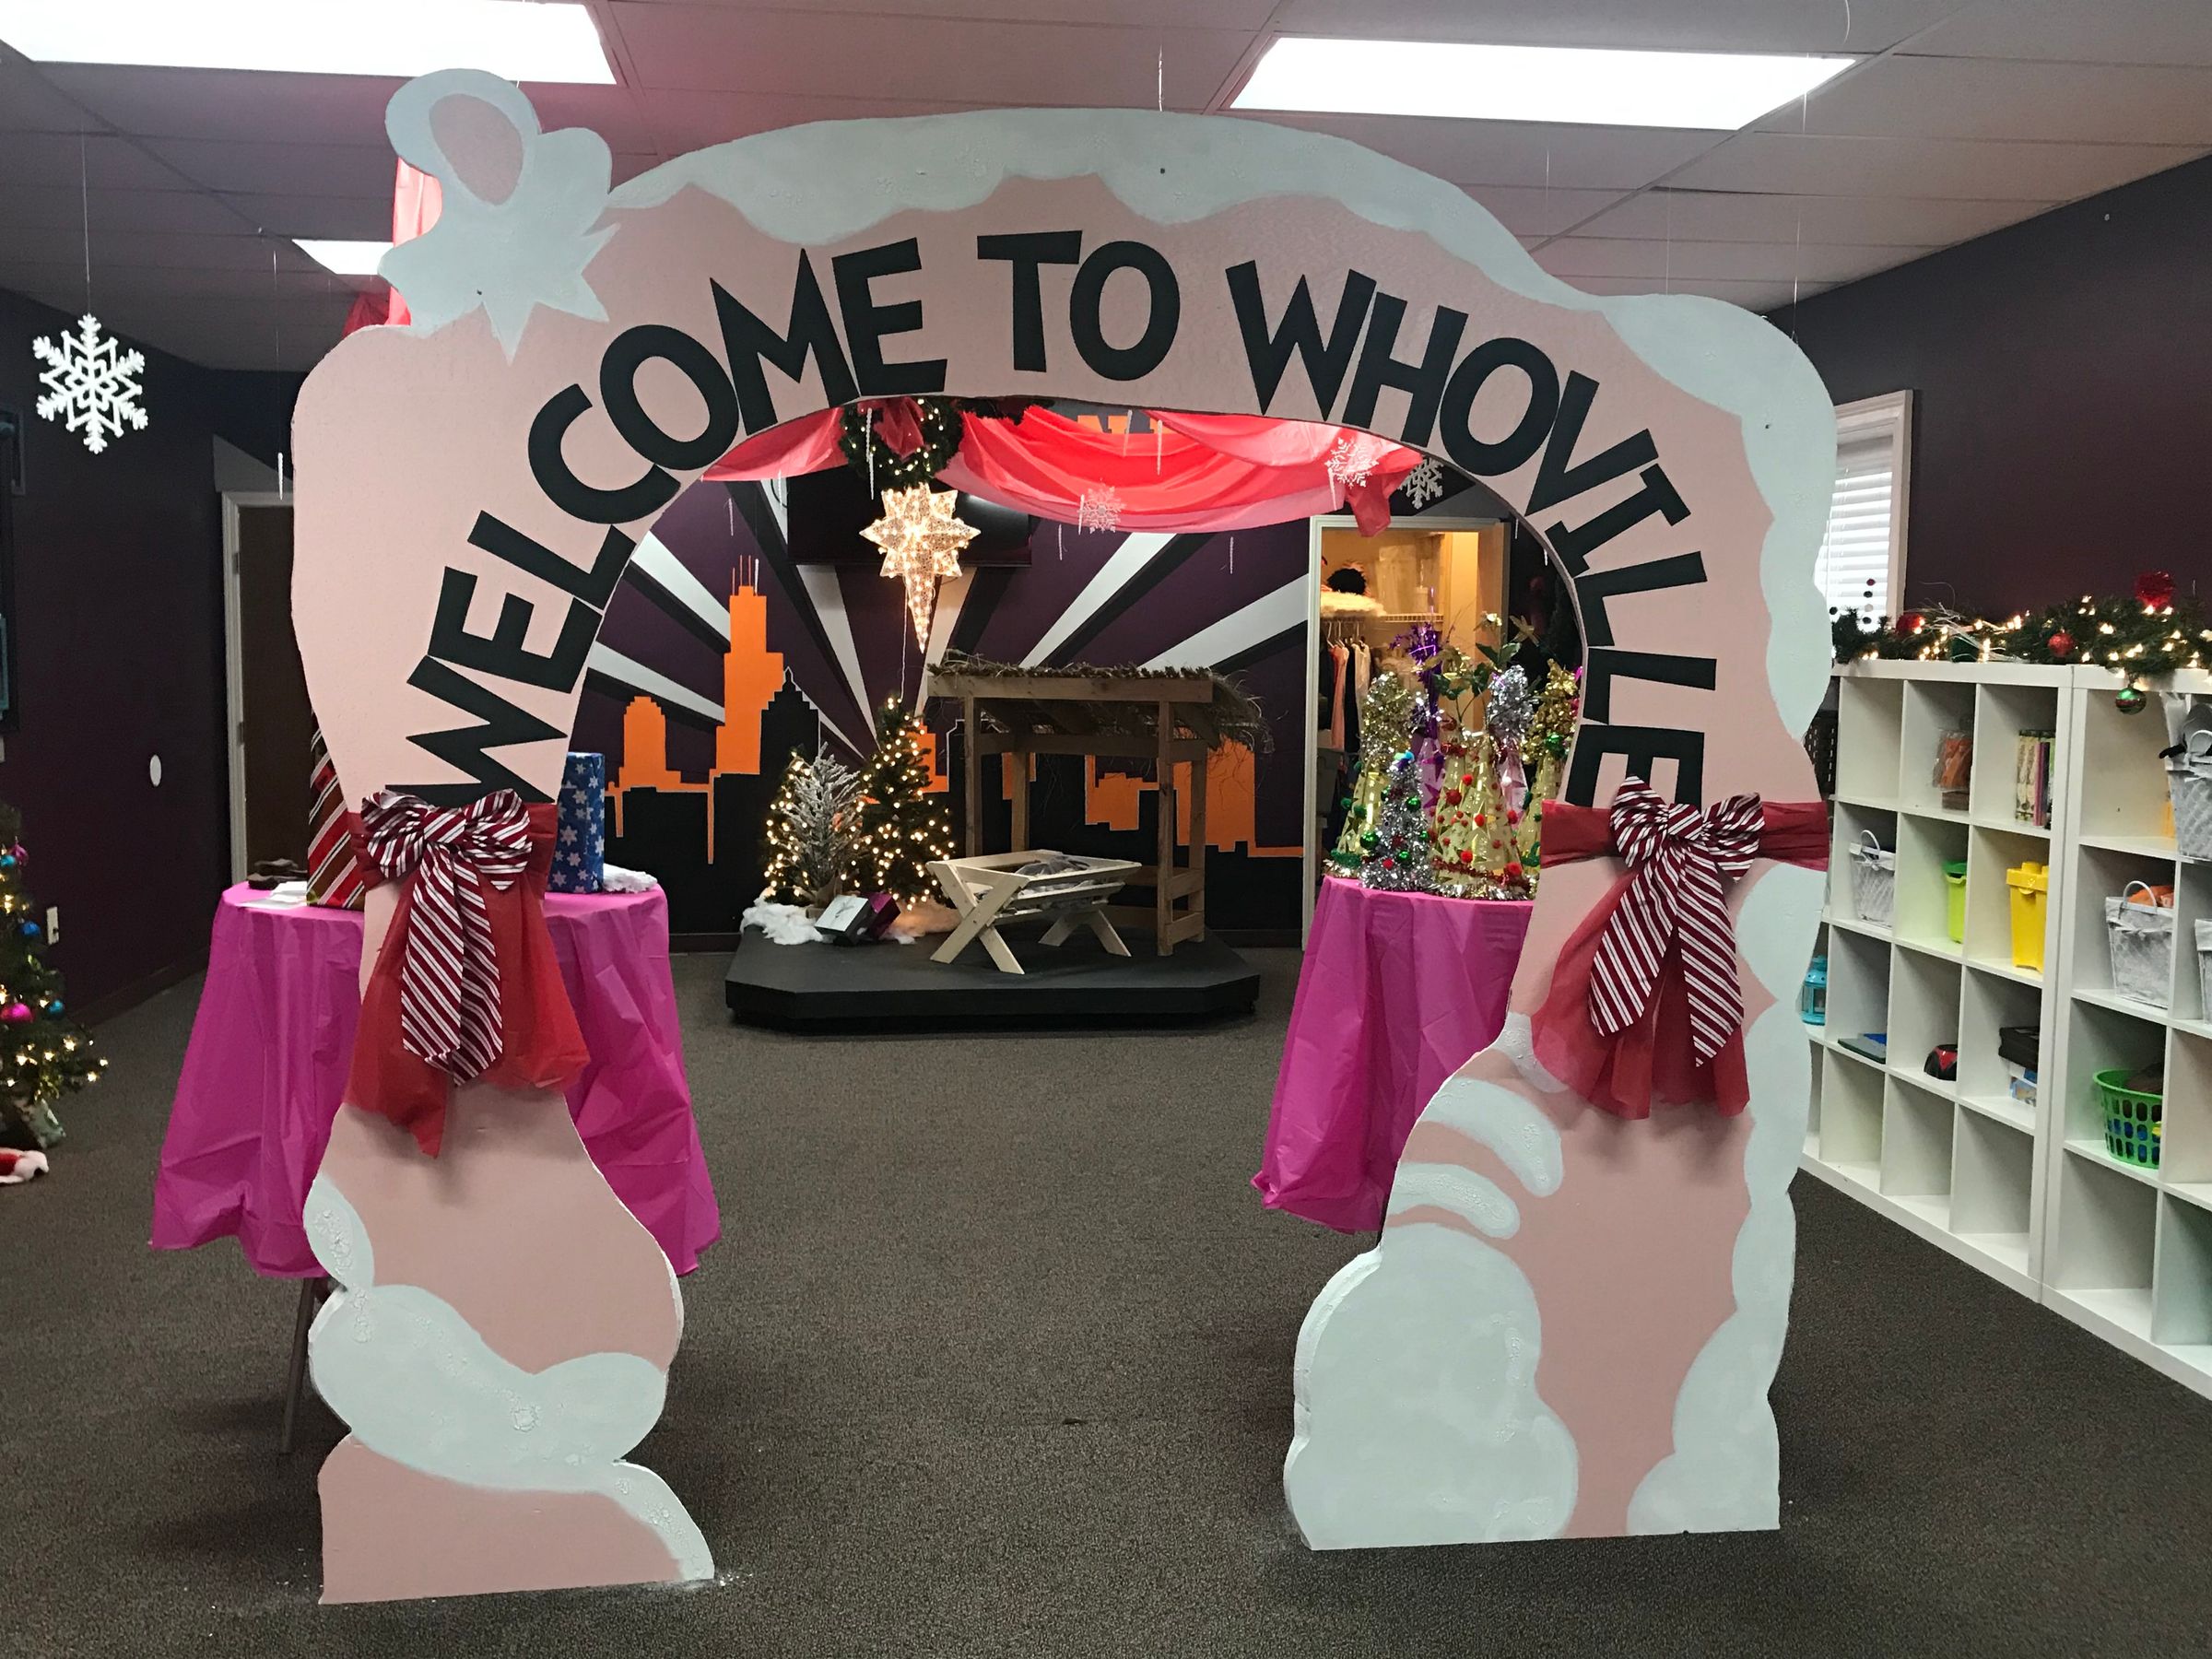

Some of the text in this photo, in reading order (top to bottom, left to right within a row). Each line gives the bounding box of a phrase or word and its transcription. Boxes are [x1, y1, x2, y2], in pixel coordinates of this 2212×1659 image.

[384, 229, 1718, 813] WELCOME TO WHOVILLE
